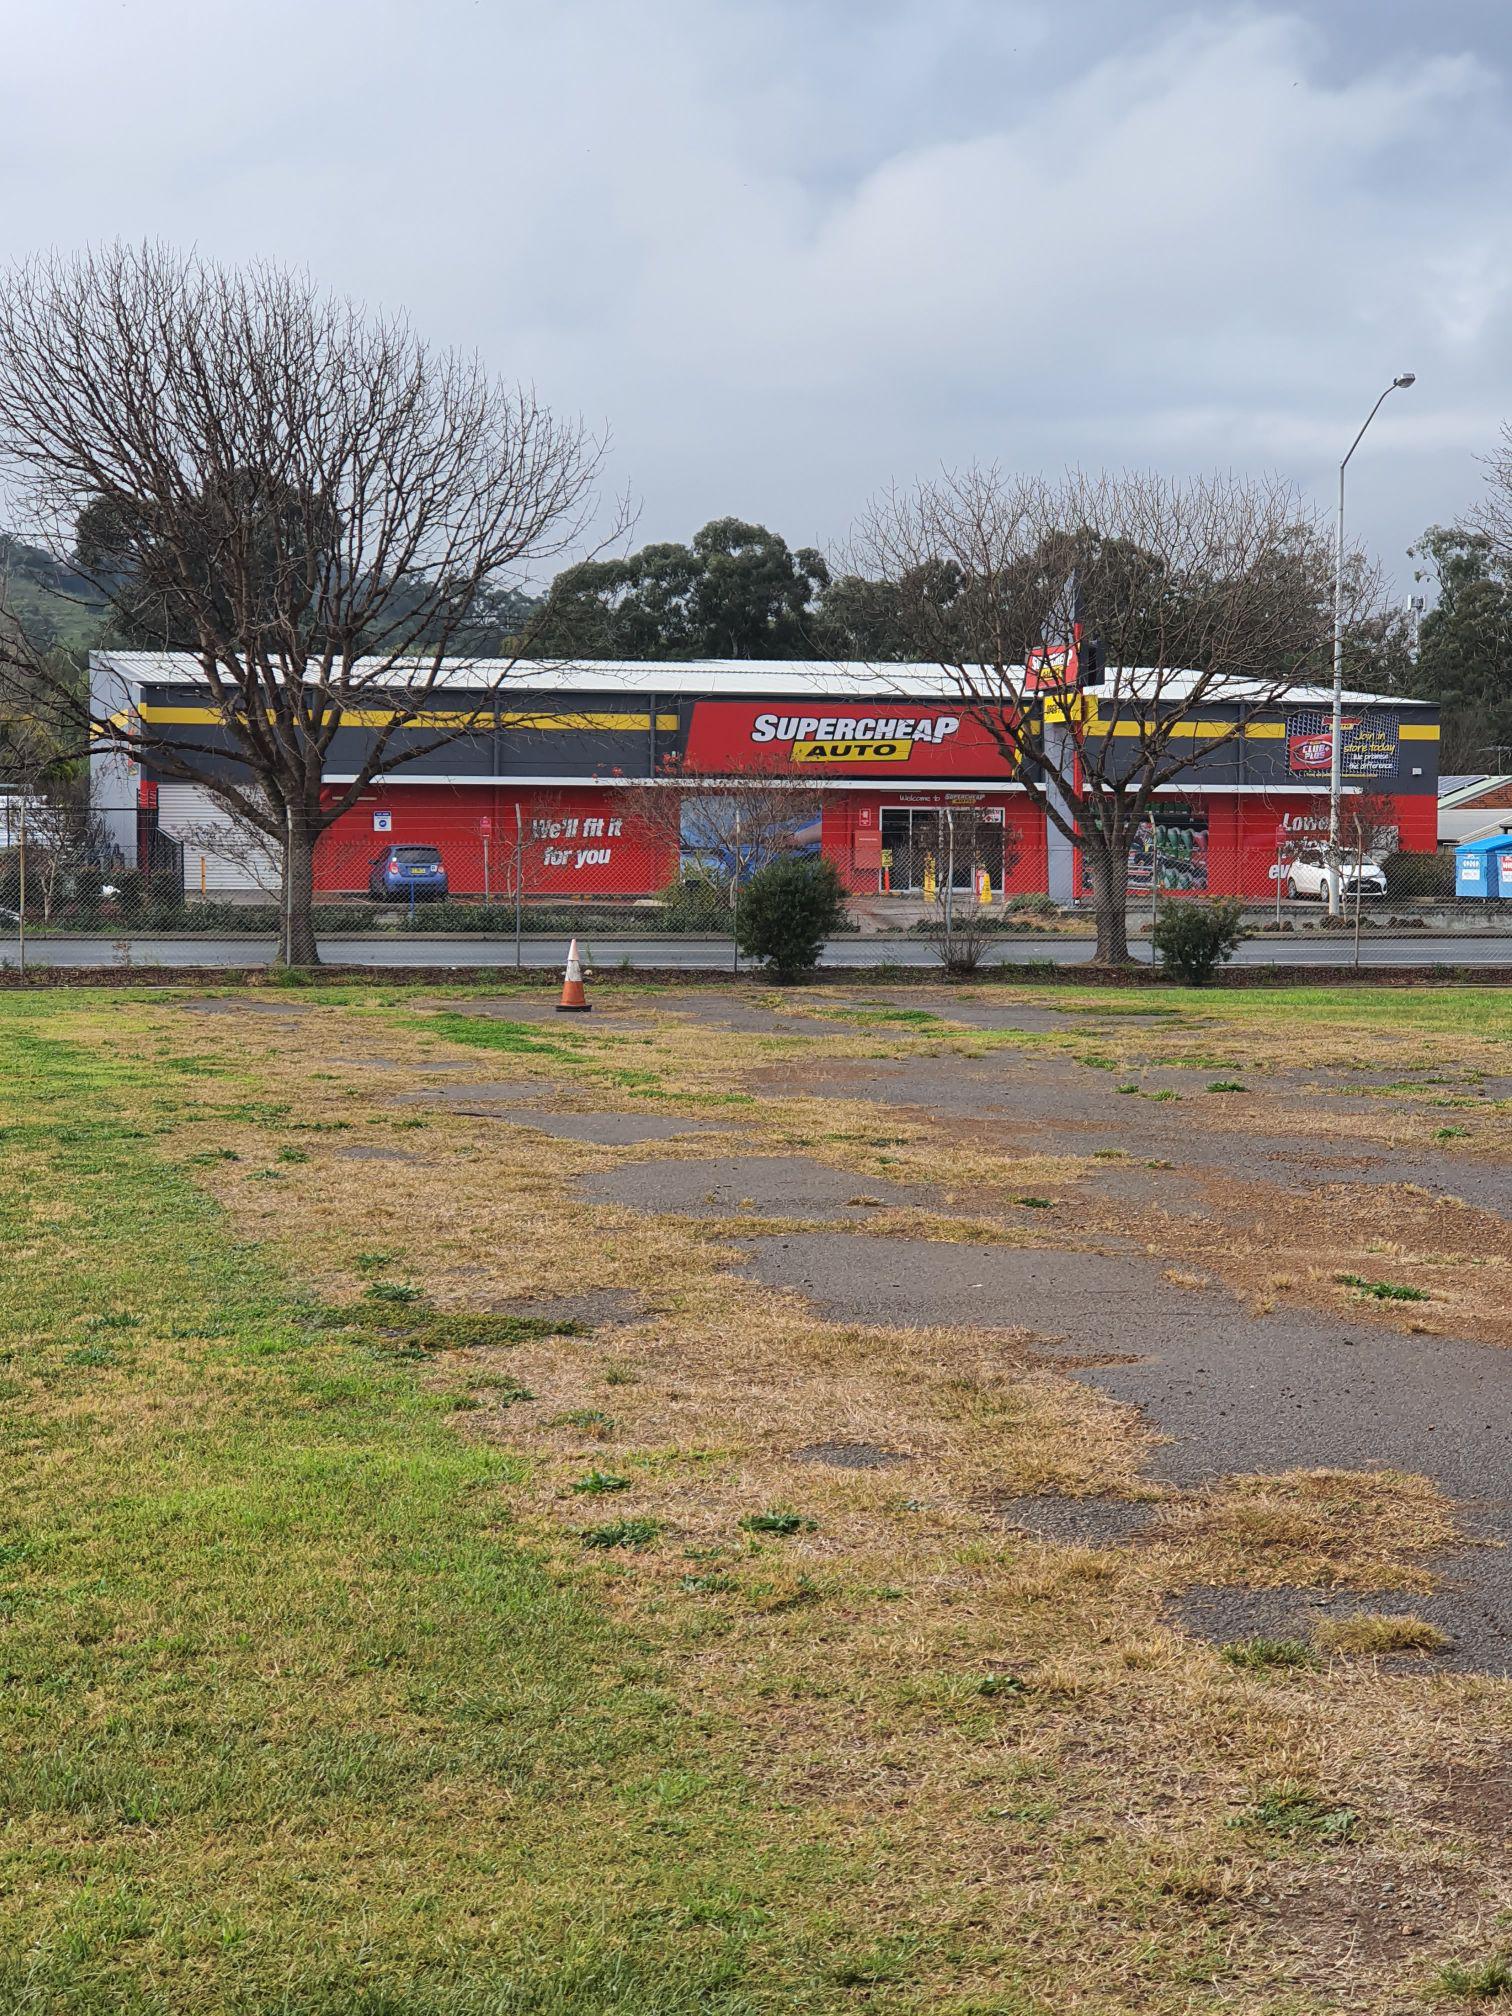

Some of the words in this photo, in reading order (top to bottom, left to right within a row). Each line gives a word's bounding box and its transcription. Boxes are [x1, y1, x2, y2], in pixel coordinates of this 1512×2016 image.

[751, 714, 960, 744] SUPERCHEAP
[806, 744, 897, 757] AUTO
[1344, 743, 1368, 753] store
[1370, 742, 1395, 755] today
[900, 794, 931, 802] Welcome
[532, 818, 579, 838] We'll
[583, 817, 605, 837] fit
[607, 817, 623, 836] it
[543, 846, 572, 866] for
[574, 848, 612, 869] you
